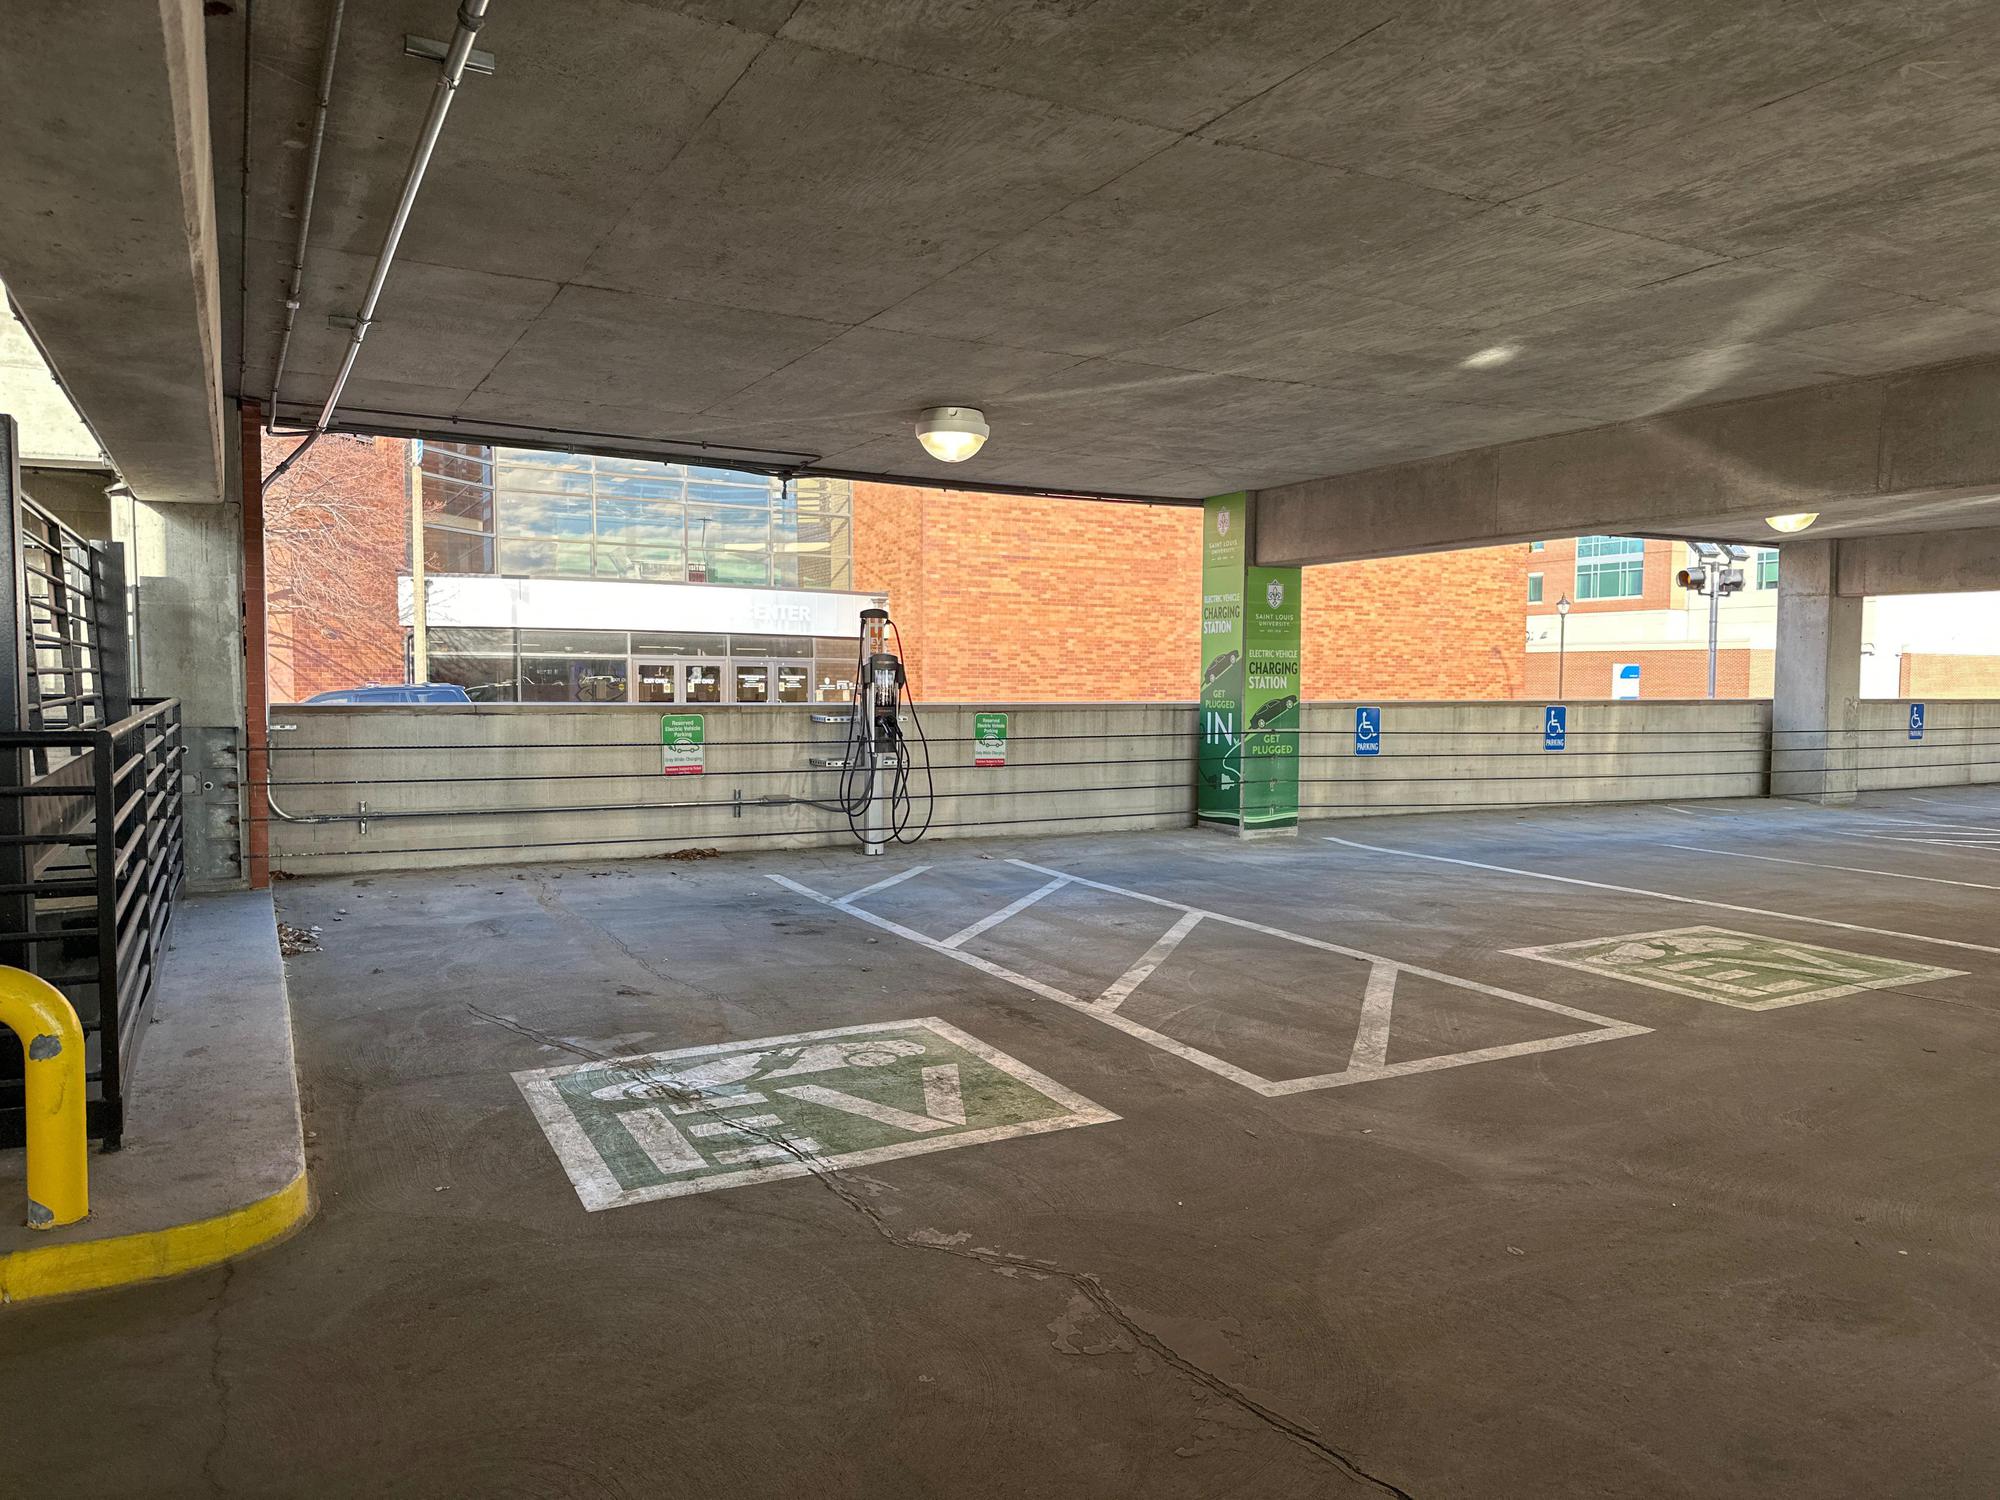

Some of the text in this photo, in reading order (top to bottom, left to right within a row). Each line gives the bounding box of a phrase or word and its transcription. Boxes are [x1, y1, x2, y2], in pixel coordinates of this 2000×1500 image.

[1204, 593, 1240, 604] ELECTRIC VEHICLE
[1204, 605, 1241, 620] CHARGING
[1203, 620, 1232, 634] STATION
[1249, 650, 1298, 658] ELECTRIC VEHICLE
[1249, 661, 1298, 675] CHARGING
[1248, 676, 1287, 689] STATION
[1212, 689, 1226, 698] GET
[1205, 700, 1235, 709] PLUGGED
[1263, 734, 1281, 744] GET
[1546, 738, 1564, 747] PARKING
[1252, 745, 1293, 755] PLUGGED
[1356, 742, 1379, 751] PARKING
[1634, 948, 1880, 998] EV
[615, 1064, 966, 1174] EV
